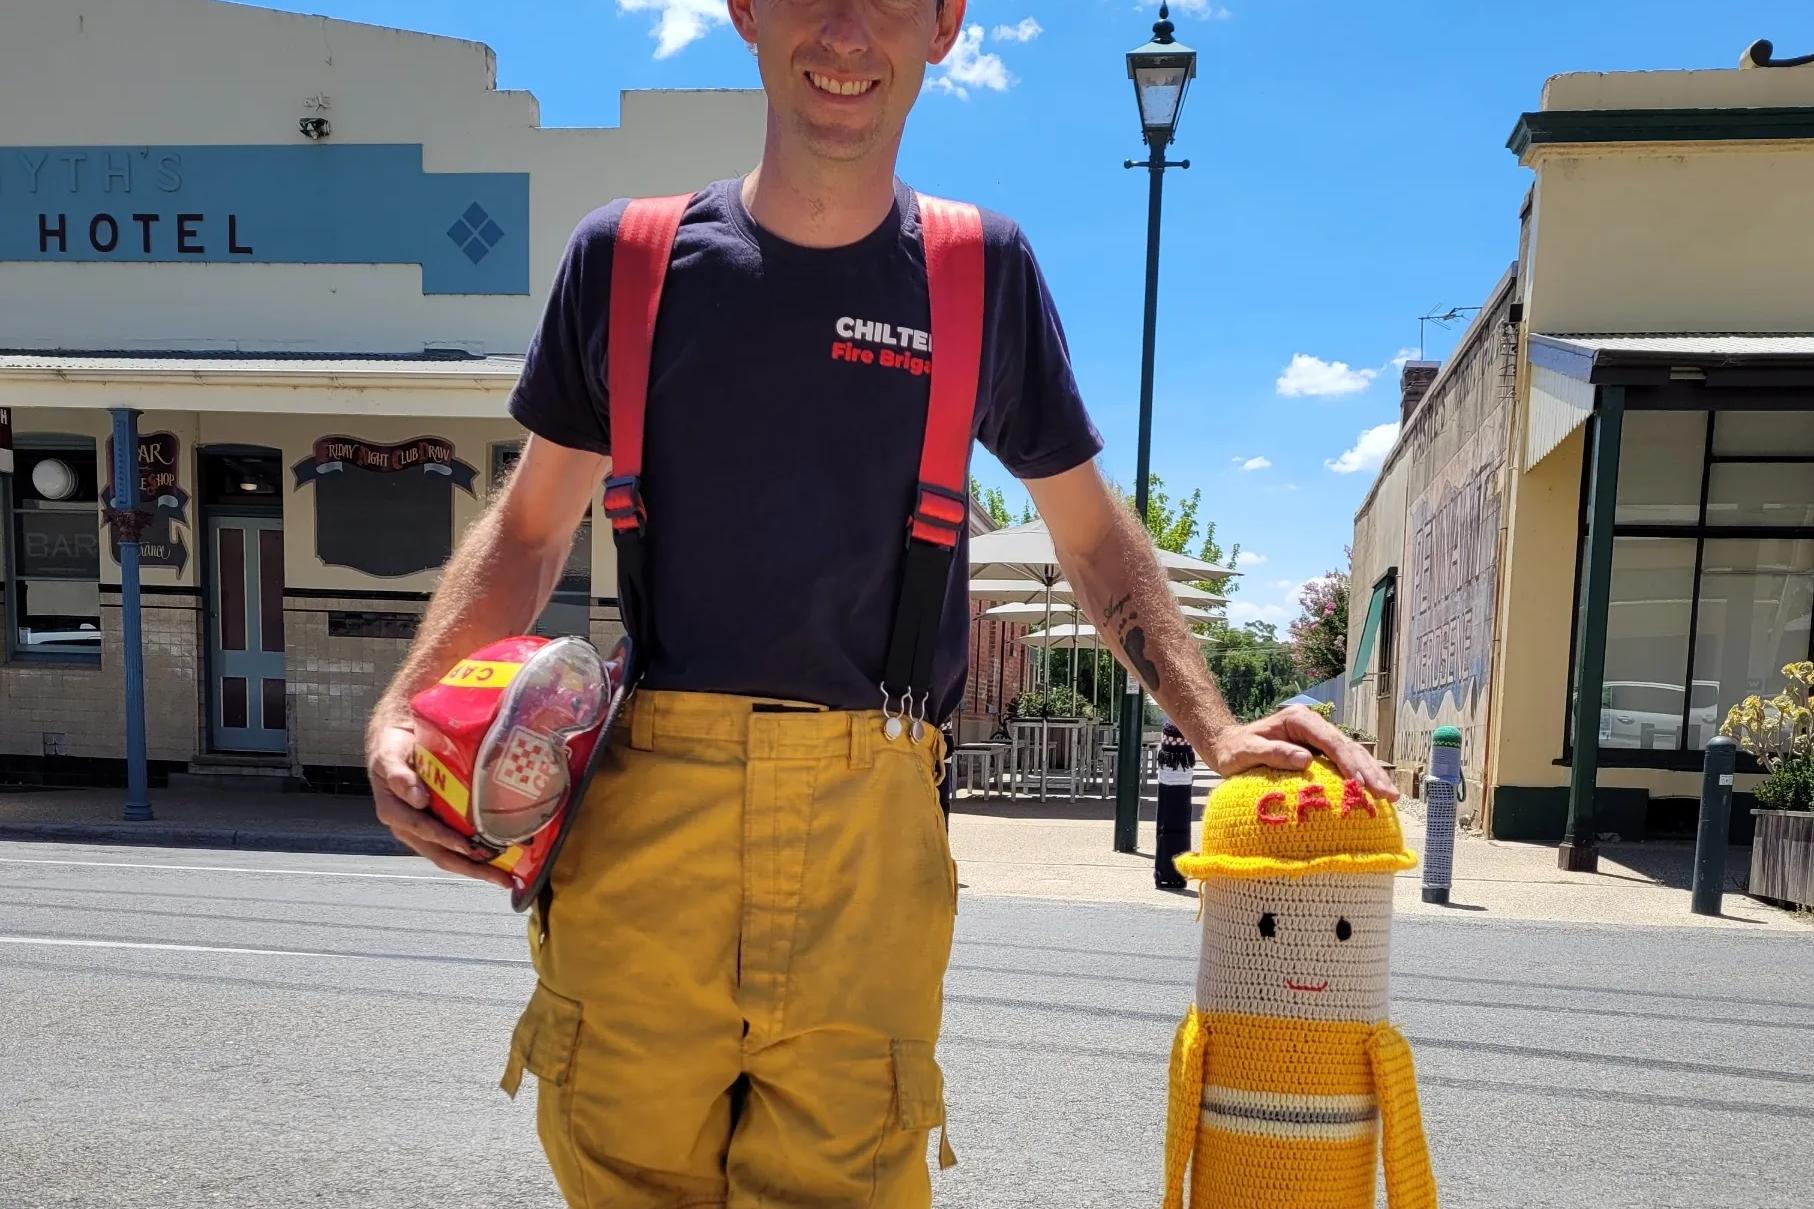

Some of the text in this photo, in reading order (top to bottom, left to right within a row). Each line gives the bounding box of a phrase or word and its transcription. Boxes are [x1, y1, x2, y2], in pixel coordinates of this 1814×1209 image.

[0, 147, 183, 194] YTH'S
[38, 212, 253, 254] HOTEL
[836, 316, 932, 352] CHILTE
[831, 342, 874, 365] Fire
[138, 442, 175, 465] AR
[317, 442, 451, 470] FRIDAY NIGHT CLUB DRAW
[25, 531, 97, 559] BAR
[1256, 778, 1377, 825] CFA
